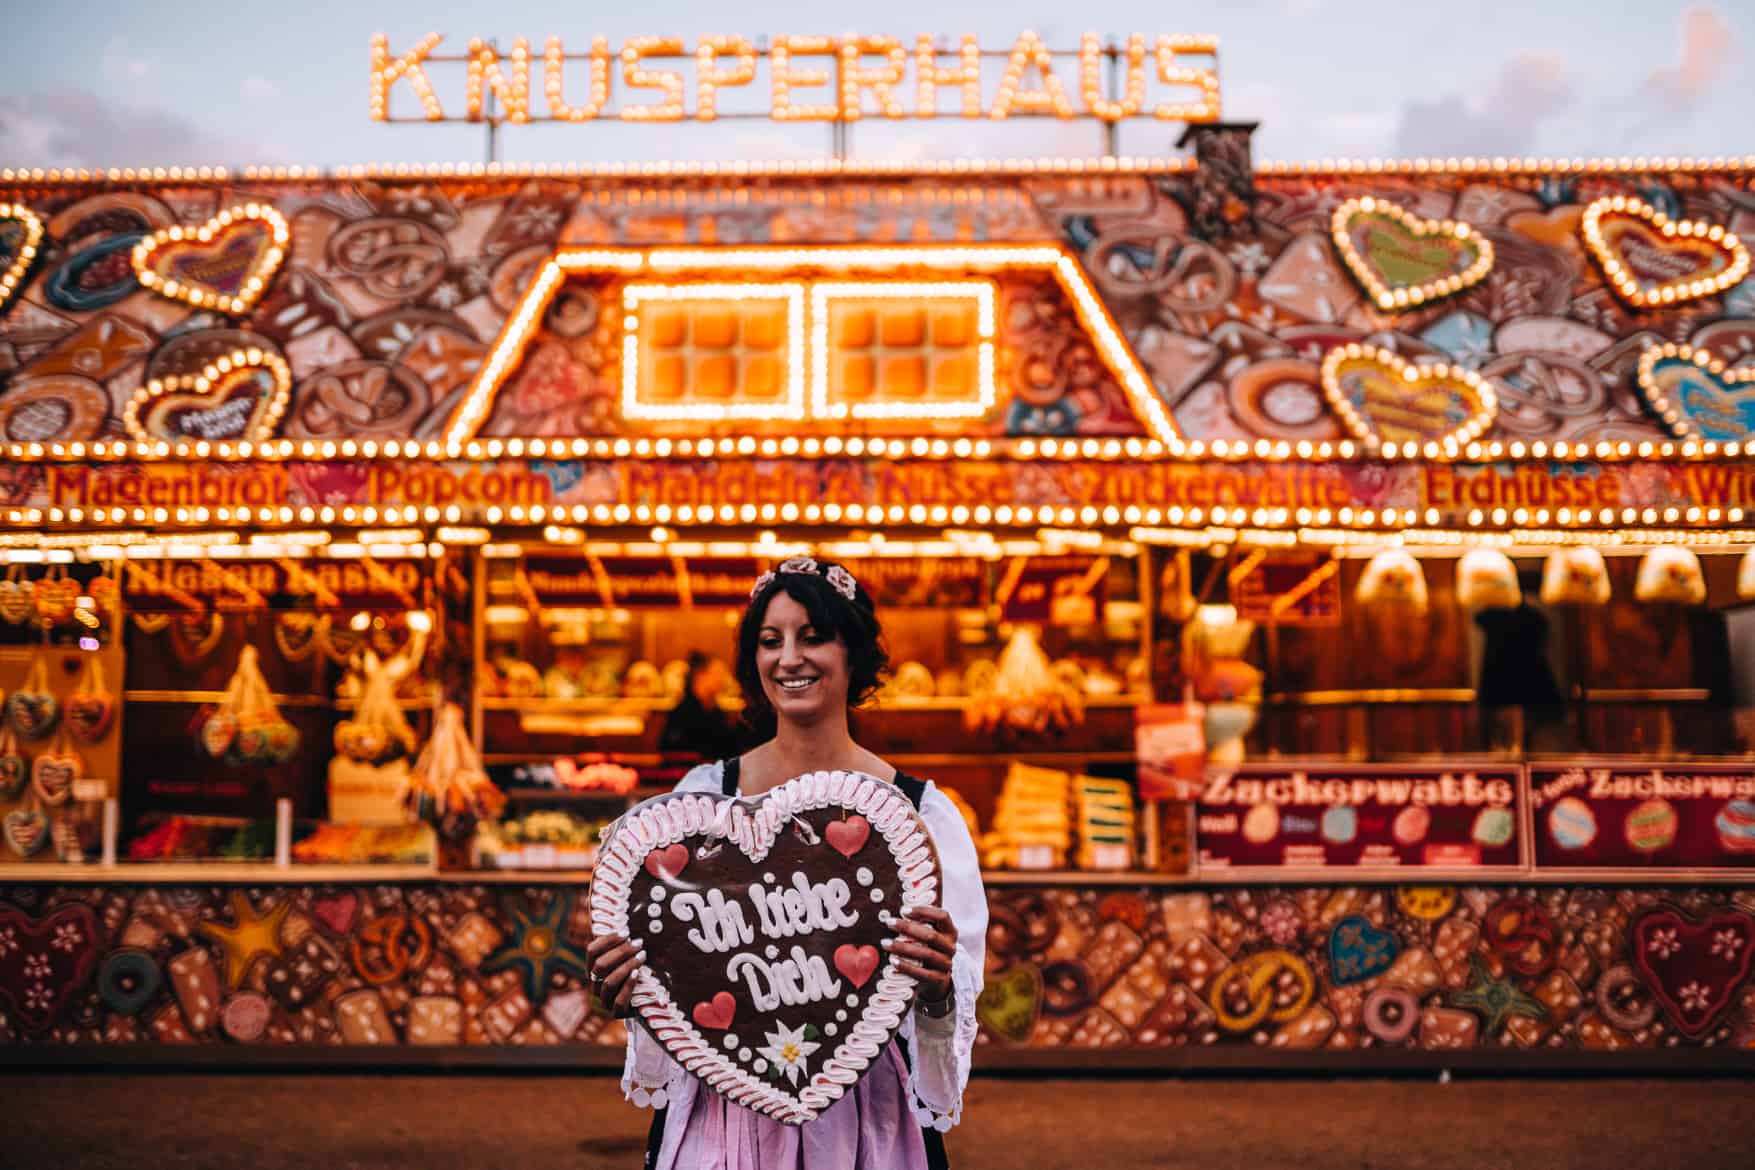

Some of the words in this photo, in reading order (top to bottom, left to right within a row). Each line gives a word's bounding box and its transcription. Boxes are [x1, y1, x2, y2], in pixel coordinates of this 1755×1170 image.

[370, 32, 1222, 122] KNUSPERHAUS
[50, 464, 288, 505] Magenbrot
[370, 463, 550, 505] Popcorn
[1424, 463, 1618, 504] Erdnüsse
[1693, 464, 1755, 506] Wi
[671, 888, 754, 952] Ich
[750, 871, 859, 937] liebe
[727, 944, 842, 1012] Dich
